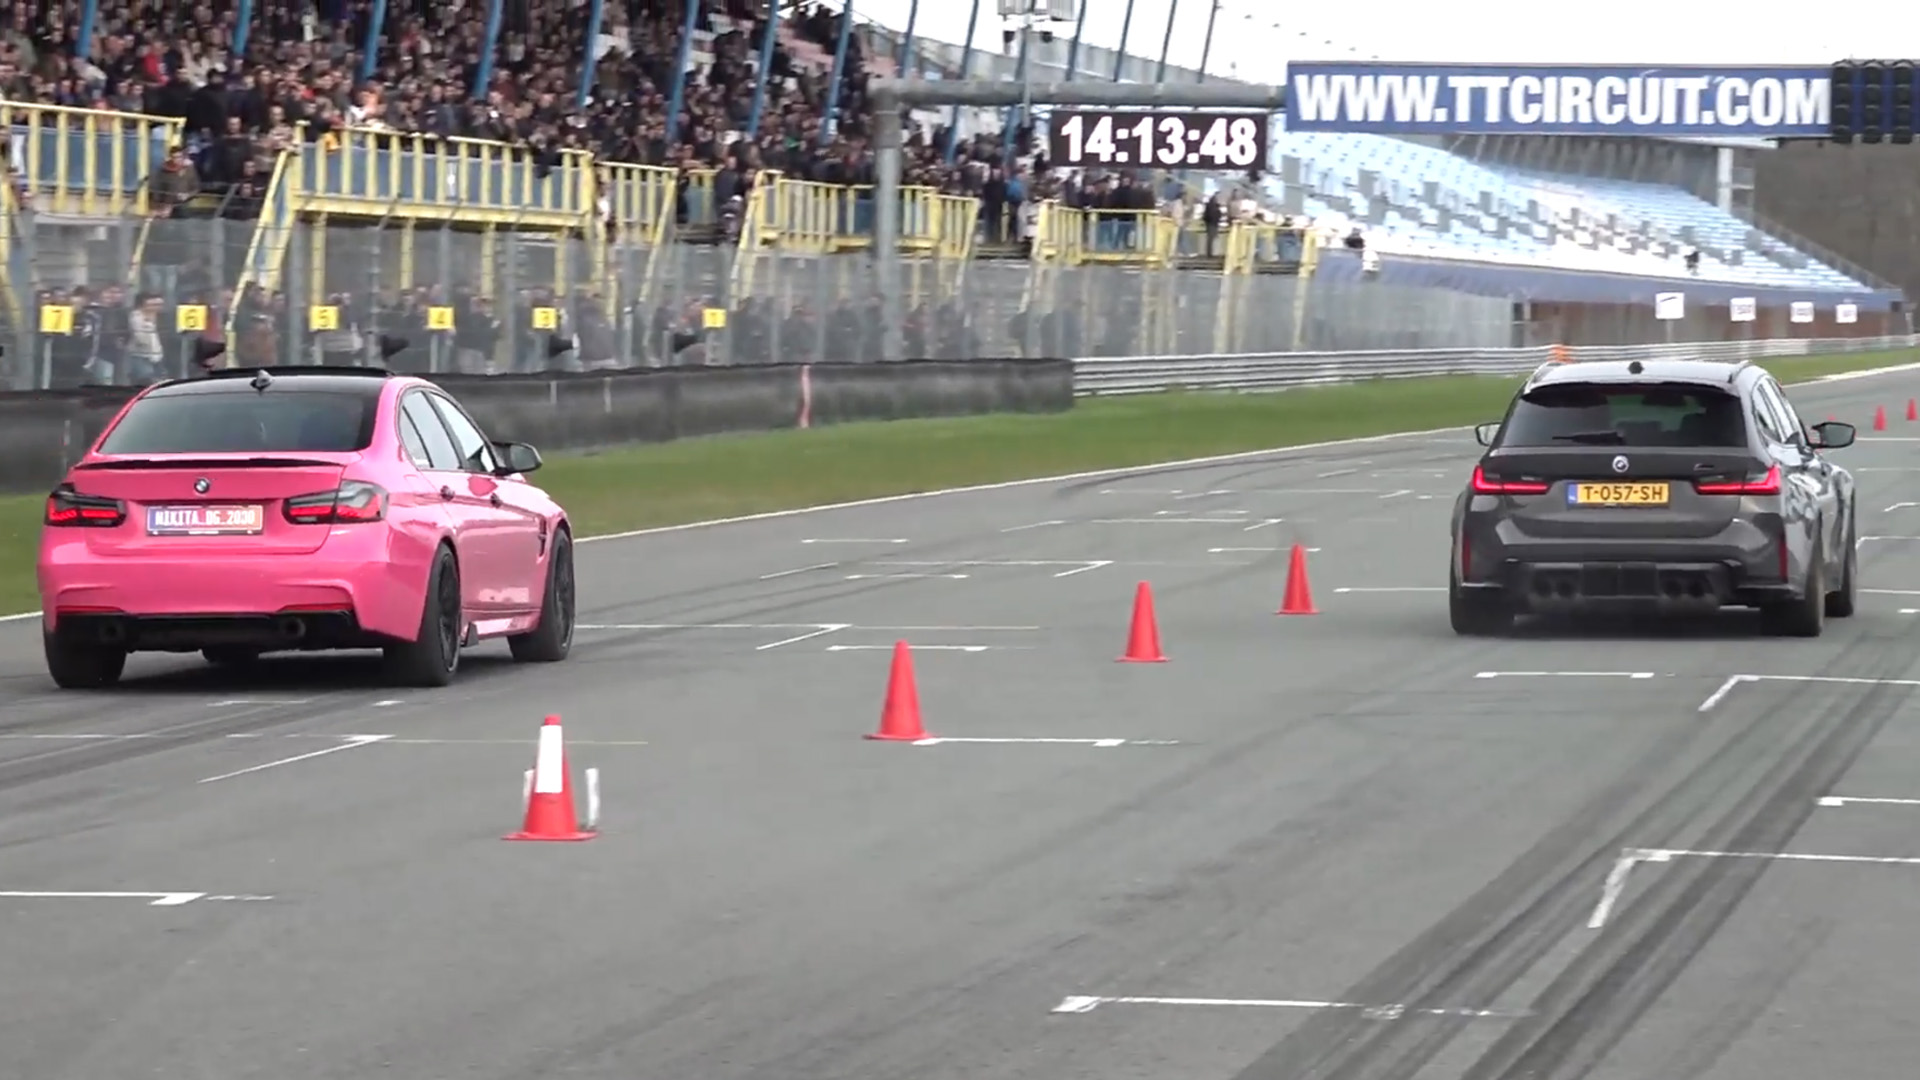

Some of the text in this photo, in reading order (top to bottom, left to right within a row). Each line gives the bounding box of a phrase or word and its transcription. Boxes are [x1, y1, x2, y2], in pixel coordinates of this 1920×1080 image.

[1294, 74, 1831, 126] WWW.TTCIRCUIT.COM
[1060, 115, 1258, 166] 14:13:48
[51, 309, 63, 330] 7
[185, 308, 198, 328] 6
[318, 308, 329, 328] 5
[1583, 485, 1663, 501] T-057-SH
